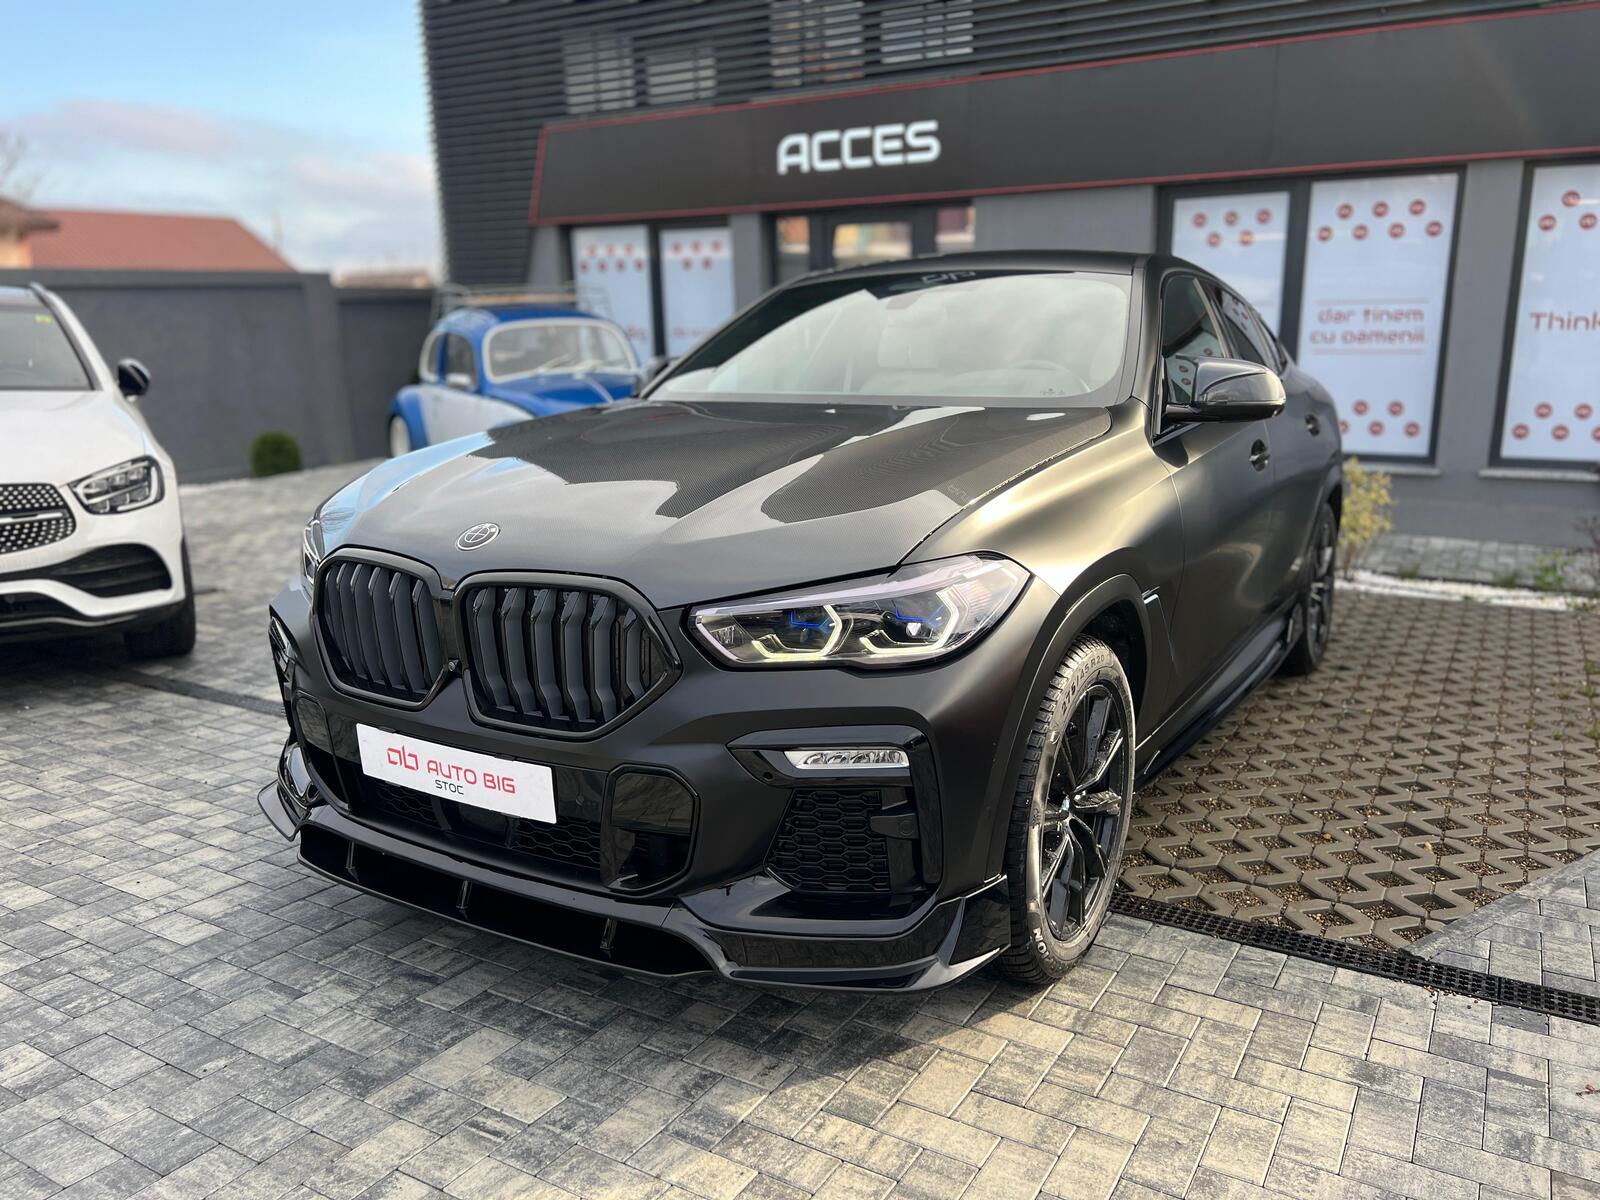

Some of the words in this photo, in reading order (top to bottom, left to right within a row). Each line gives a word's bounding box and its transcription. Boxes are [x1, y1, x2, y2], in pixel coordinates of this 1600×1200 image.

[776, 119, 941, 175] ACCES
[427, 760, 477, 785] AUTO
[483, 772, 516, 794] BIG
[434, 779, 464, 795] STOC
